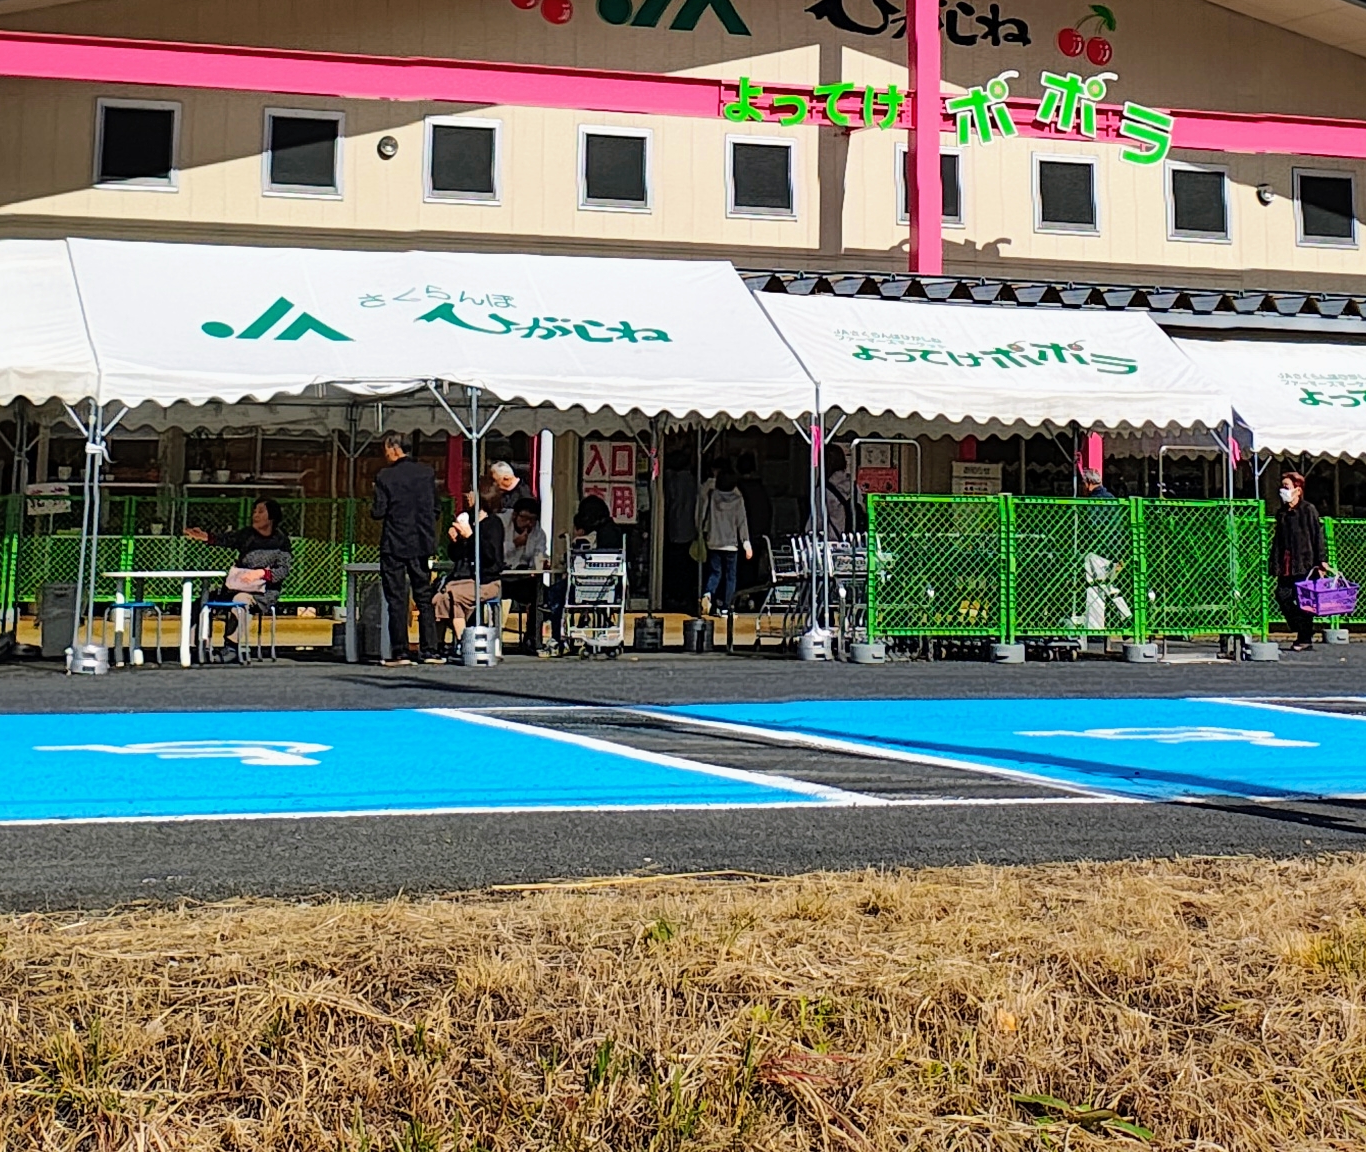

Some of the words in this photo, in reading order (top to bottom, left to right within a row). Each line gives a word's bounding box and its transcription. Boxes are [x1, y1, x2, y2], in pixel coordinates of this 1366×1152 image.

[722, 76, 906, 130] よってけ
[945, 69, 1175, 166] ポポラ
[358, 285, 516, 308] さくらんぼ
[852, 341, 1138, 375] よってけポポラ
[585, 444, 633, 476] 入口
